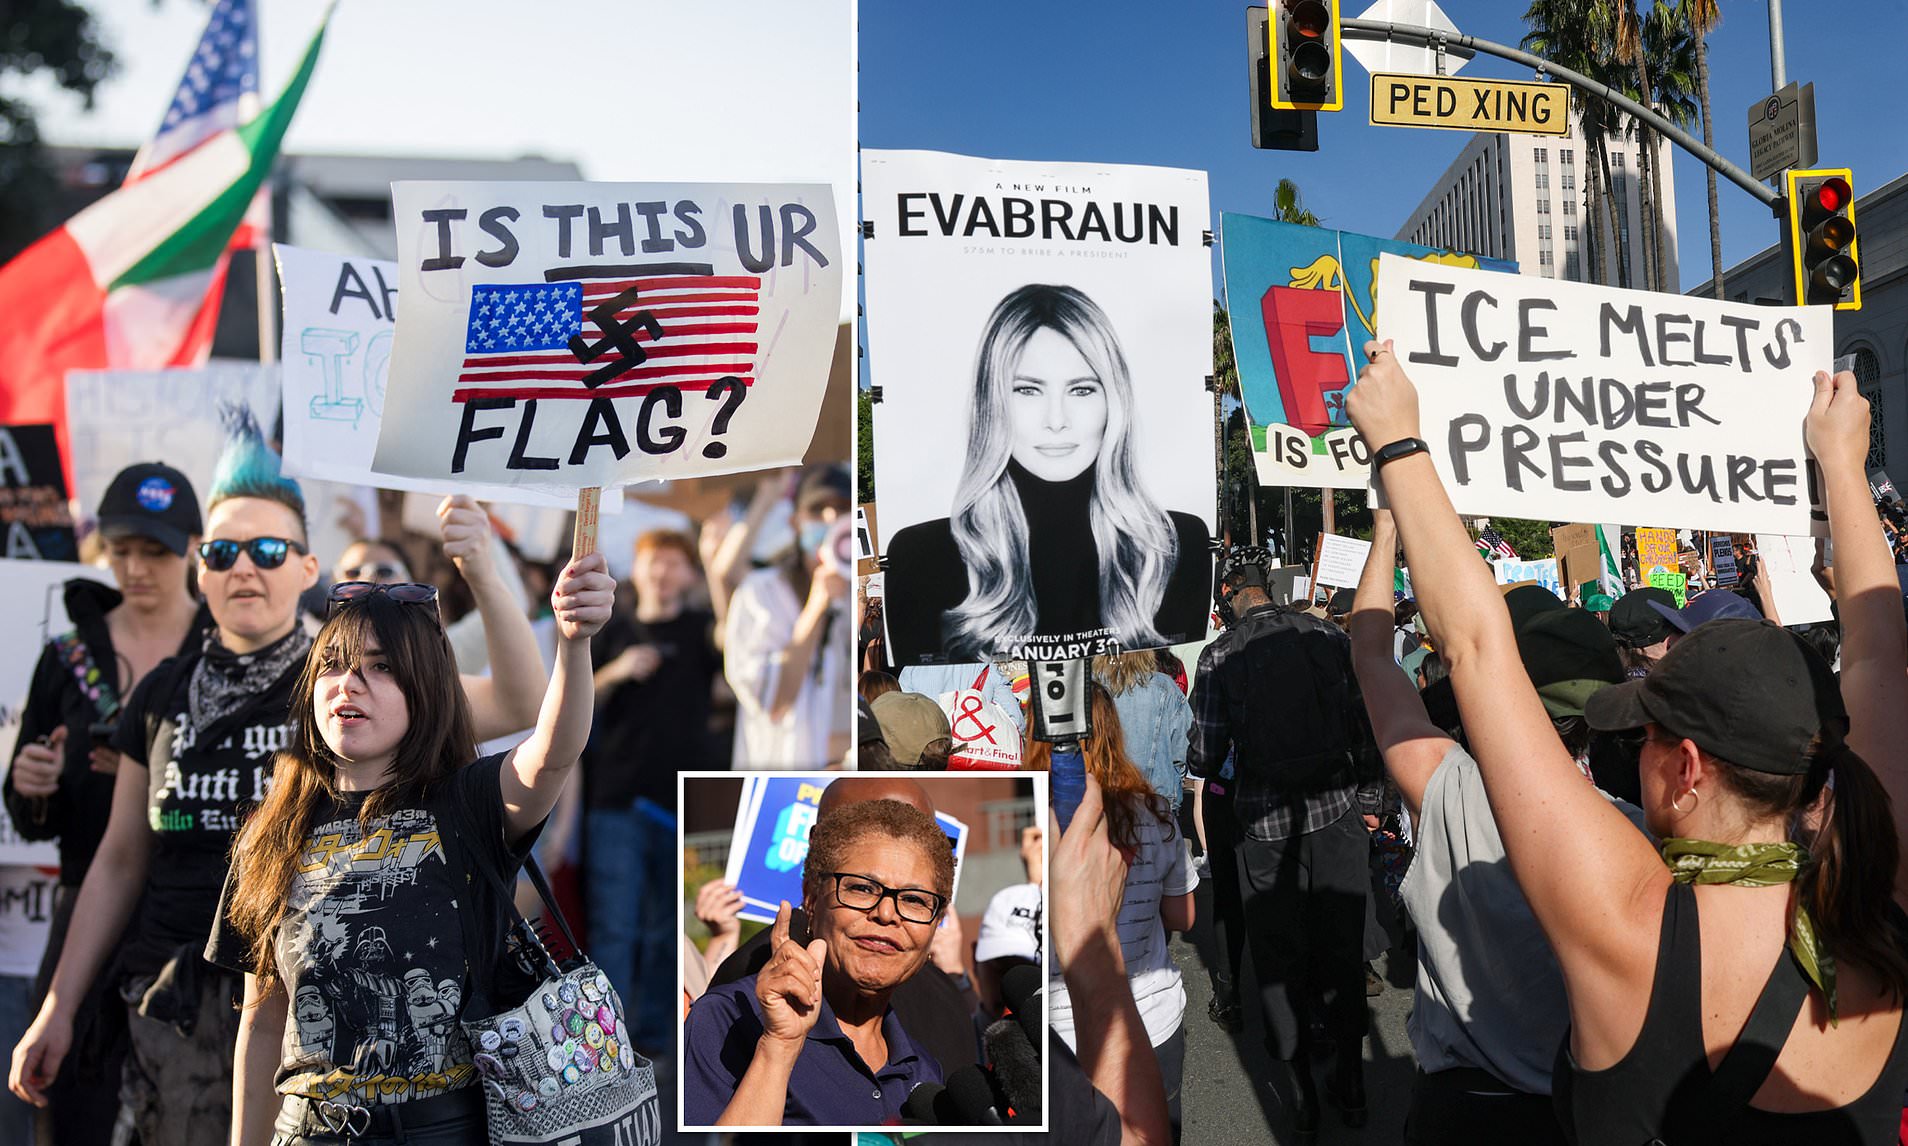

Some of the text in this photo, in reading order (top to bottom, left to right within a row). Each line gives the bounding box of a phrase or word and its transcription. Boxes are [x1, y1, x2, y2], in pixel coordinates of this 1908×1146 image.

[1390, 84, 1551, 124] PED XING
[1752, 119, 1797, 148] GLORIA MOLINA
[1754, 143, 1773, 159] LEGACY
[1013, 184, 1045, 192] NEW
[1055, 185, 1092, 194] FILM
[421, 200, 830, 274] IS THIS UR
[897, 192, 1179, 247] EVABRAUN
[1000, 247, 1015, 255] TO
[1021, 248, 1051, 256] BRIBE
[1057, 249, 1065, 257] A
[1070, 250, 1129, 259] PRESIDENT
[1408, 279, 1805, 373] ICE MELTS
[1503, 370, 1722, 431] UNDER
[451, 376, 748, 474] FLAG?
[1275, 431, 1308, 469] IS
[1639, 530, 1676, 544] HANDS
[994, 627, 1121, 643] EXCLUSIVELY IN THEATERS
[1006, 641, 1092, 661] ANUARY
[155, 760, 240, 801] Anti
